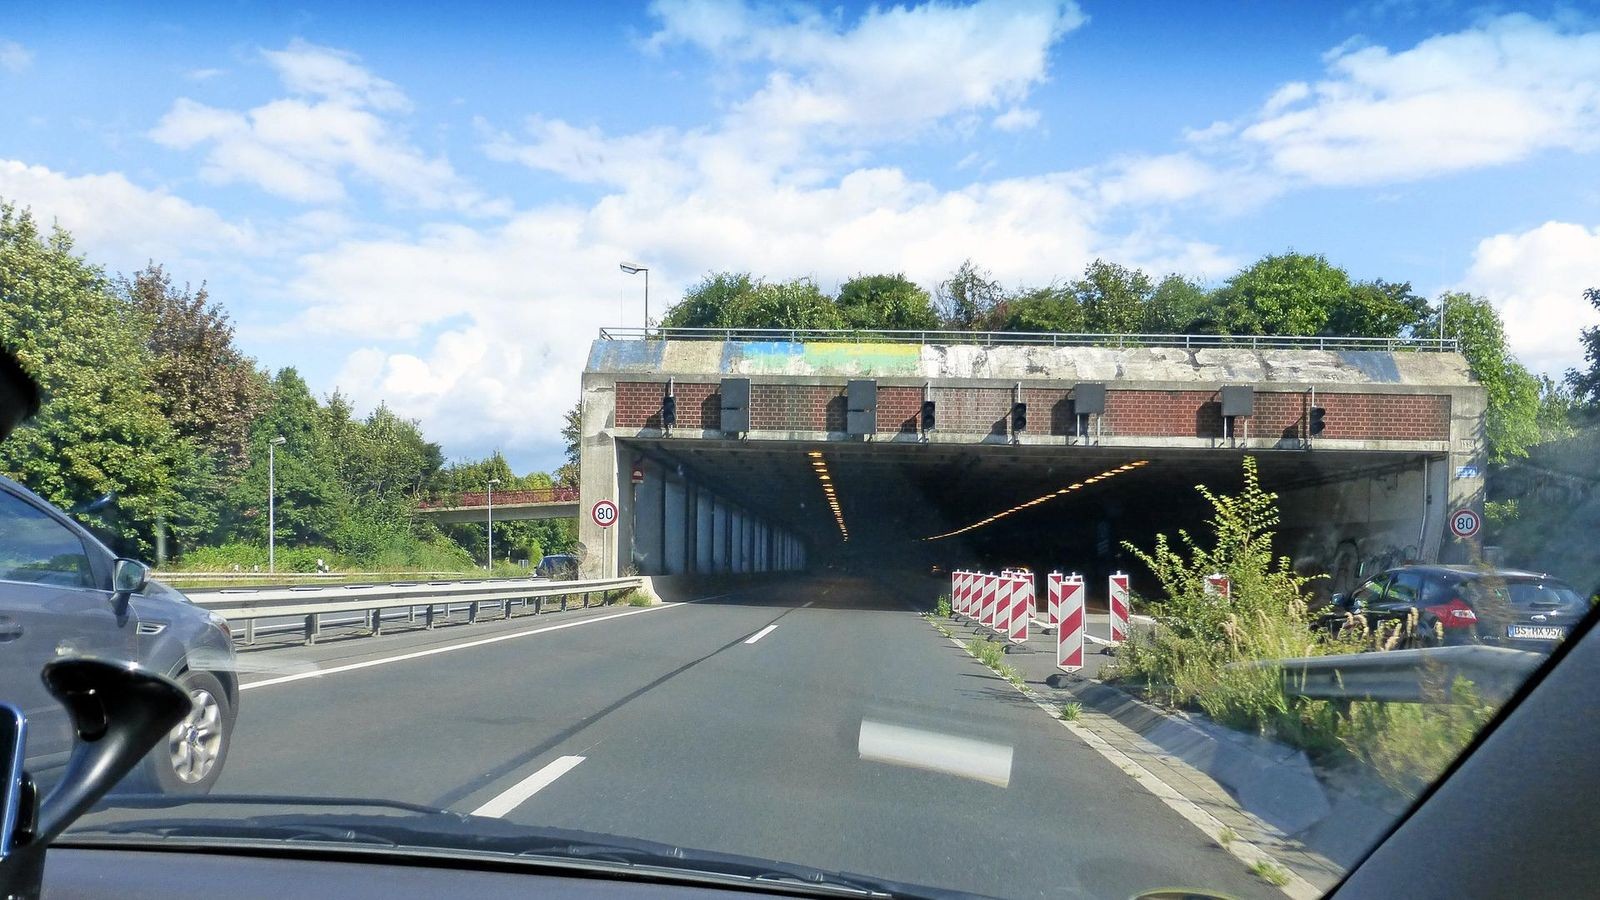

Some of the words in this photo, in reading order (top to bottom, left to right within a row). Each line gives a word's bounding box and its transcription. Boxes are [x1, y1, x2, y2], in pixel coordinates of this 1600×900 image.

[597, 507, 613, 520] 80
[1457, 517, 1474, 530] 80
[1514, 626, 1527, 635] BS
